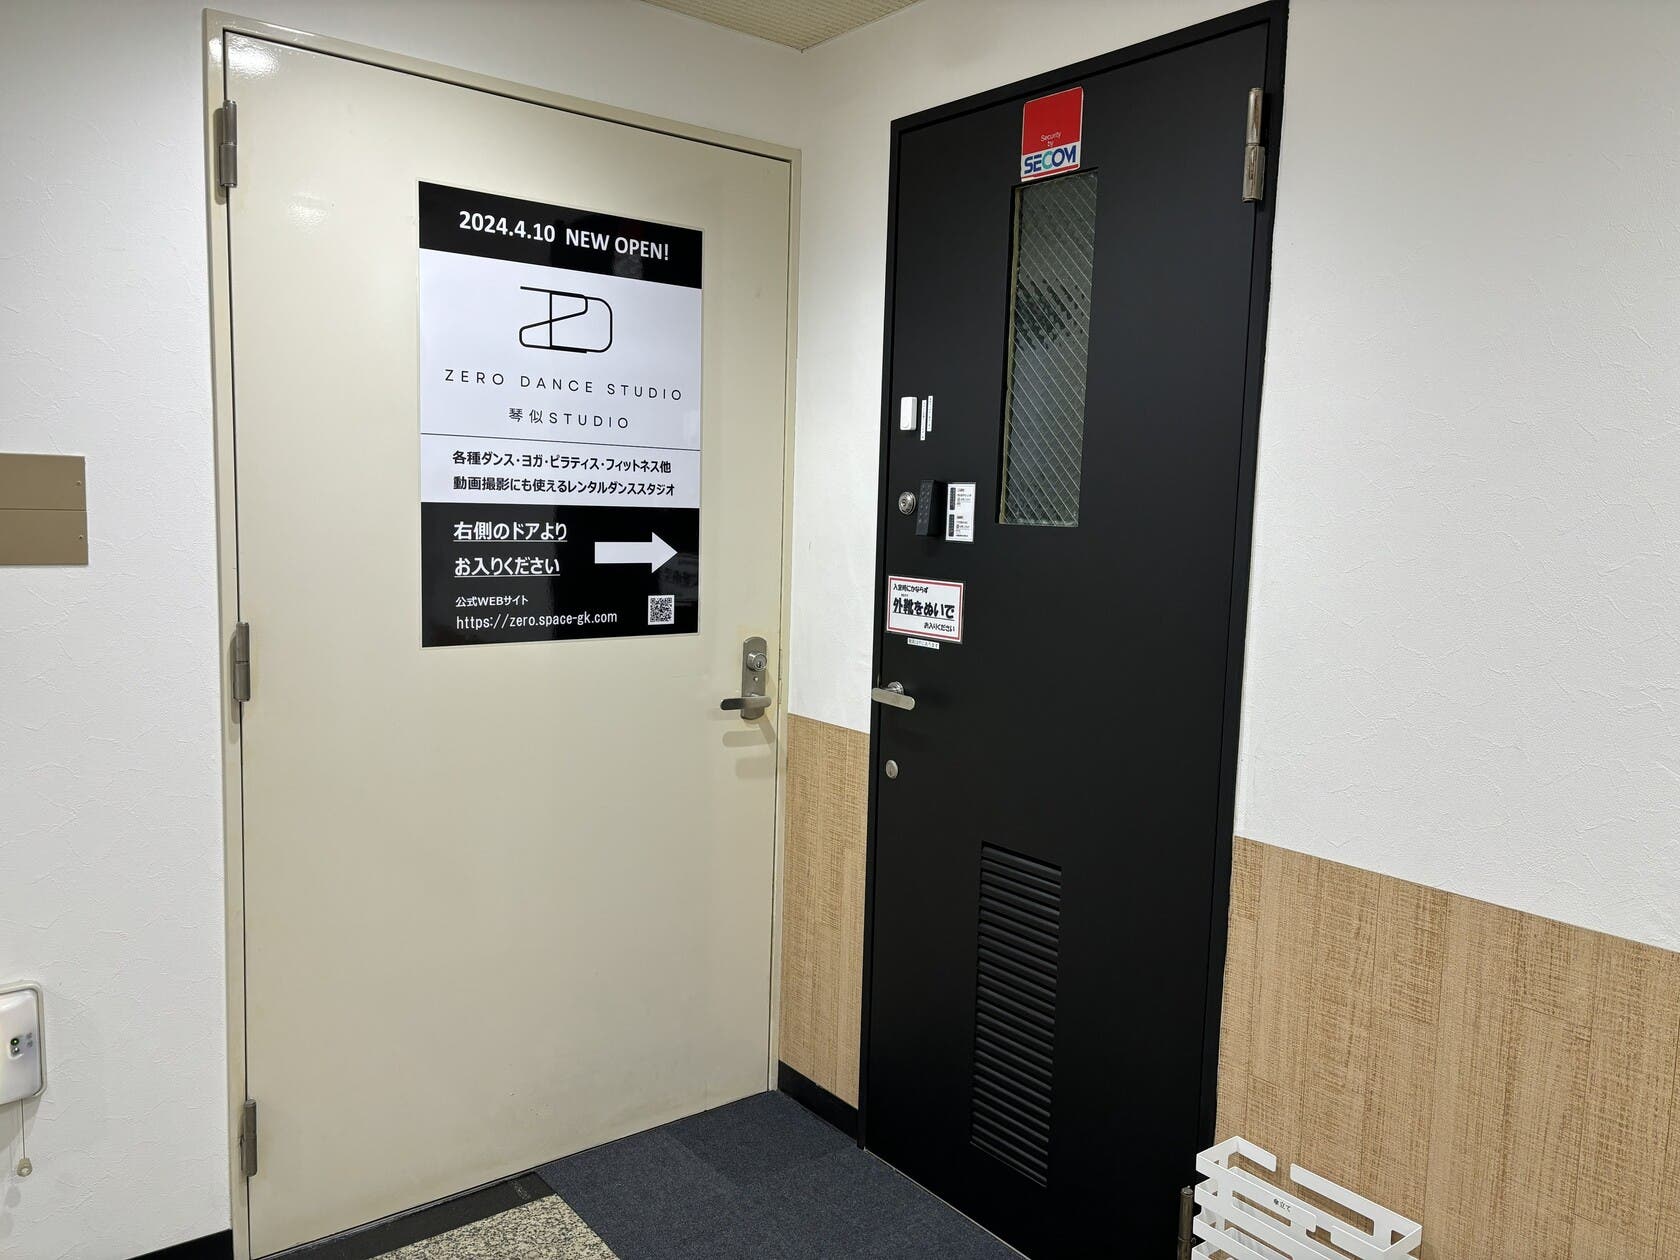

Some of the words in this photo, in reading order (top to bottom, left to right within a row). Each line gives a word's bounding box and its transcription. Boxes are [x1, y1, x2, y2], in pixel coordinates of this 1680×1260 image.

[1040, 131, 1061, 142] Security
[1024, 145, 1076, 174] SECOM
[459, 211, 556, 243] 2024.4.10
[566, 229, 610, 251] NEW
[615, 236, 669, 260] OPEN!
[445, 369, 504, 386] ZERO
[521, 376, 593, 393] DANCE
[607, 383, 682, 401] STUDIO
[453, 476, 675, 496] 動画撮影にも使えるレンタルダンススタジオ
[453, 521, 567, 541] 右側のドアより
[454, 557, 560, 576] お入りください
[455, 595, 528, 608] 公式WEBサイト
[893, 597, 955, 619] 外靴をぬいで
[456, 611, 617, 630] https://zero.space-gk.com
[924, 622, 955, 632] お入りください
